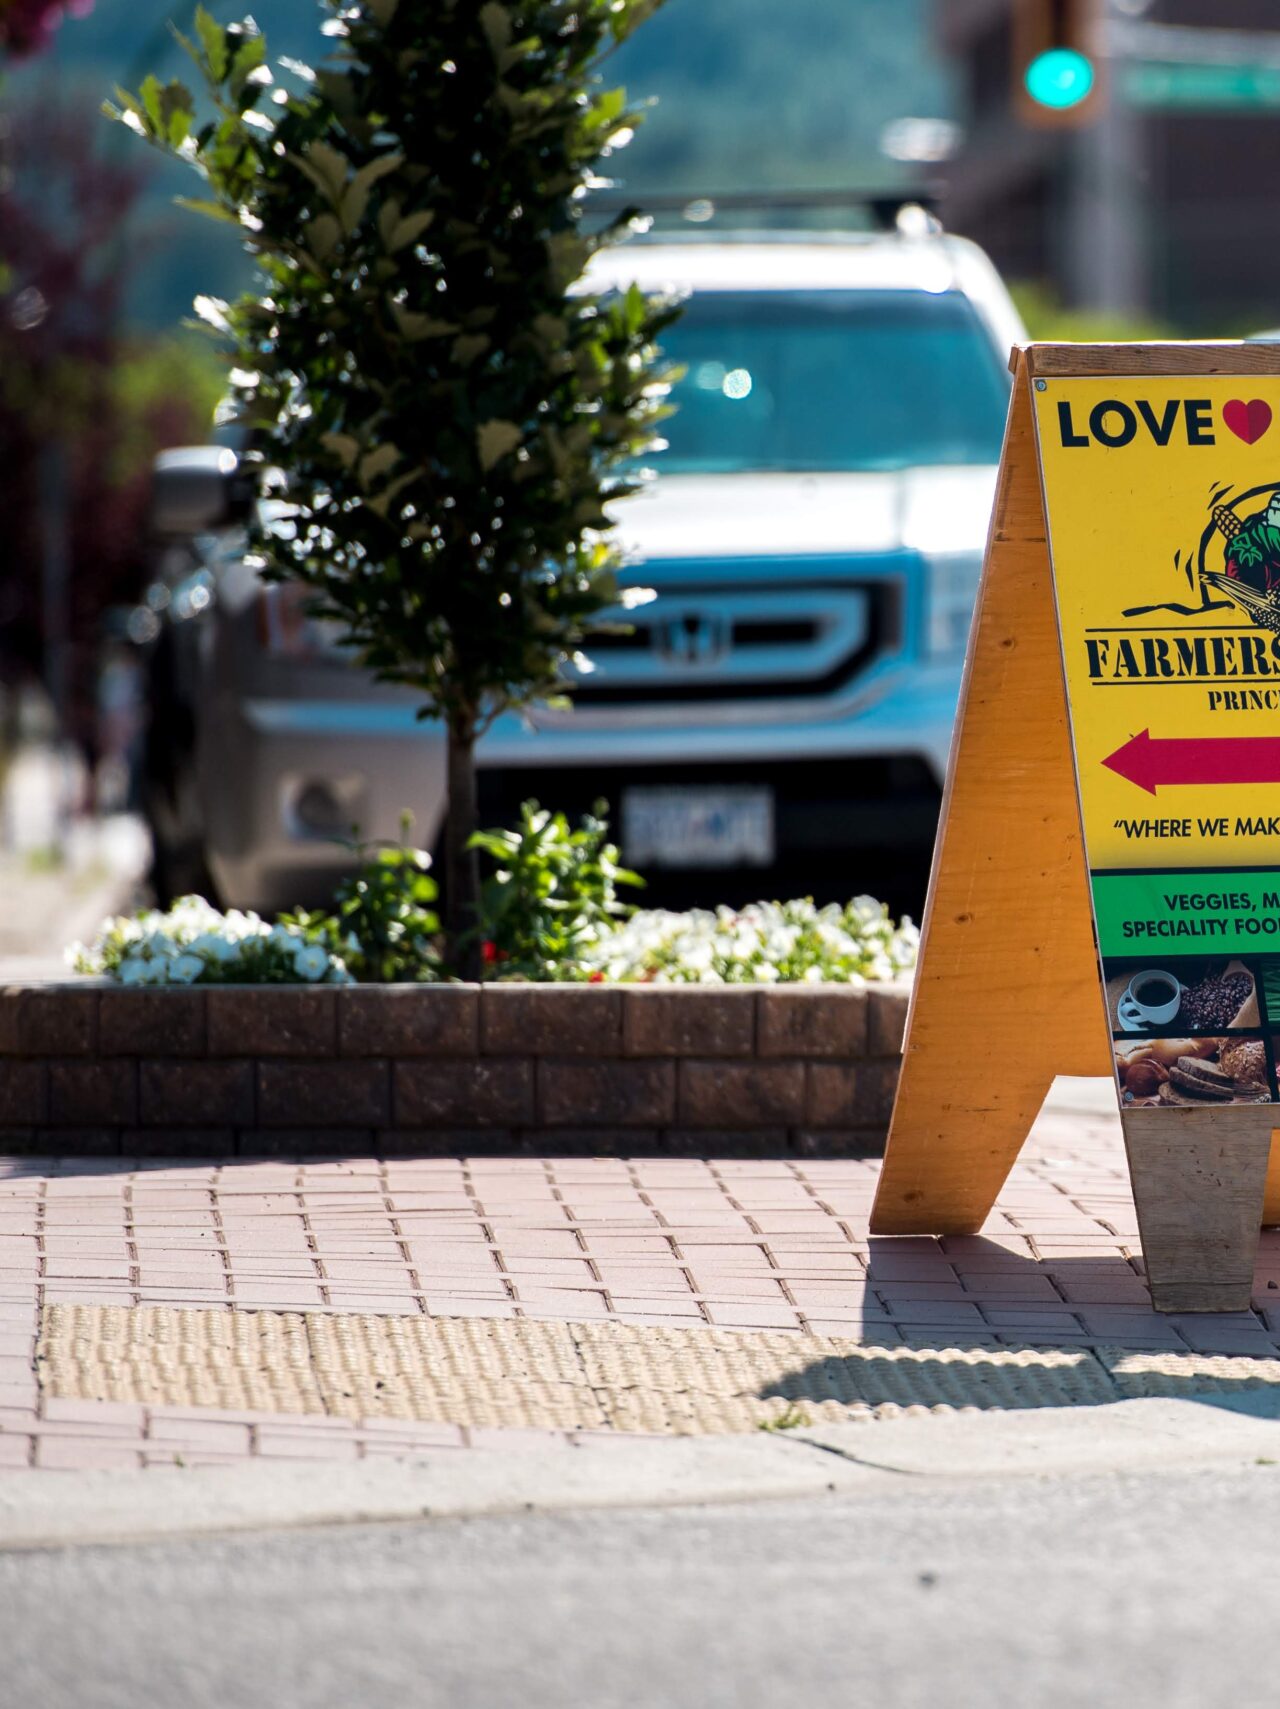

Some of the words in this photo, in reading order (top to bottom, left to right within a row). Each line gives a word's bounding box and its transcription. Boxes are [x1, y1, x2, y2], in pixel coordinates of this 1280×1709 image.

[1058, 399, 1216, 448] LOVE
[1197, 818, 1229, 837] WE
[1163, 892, 1257, 912] VEGGIES,
[1122, 918, 1229, 938] SPECIALITY
